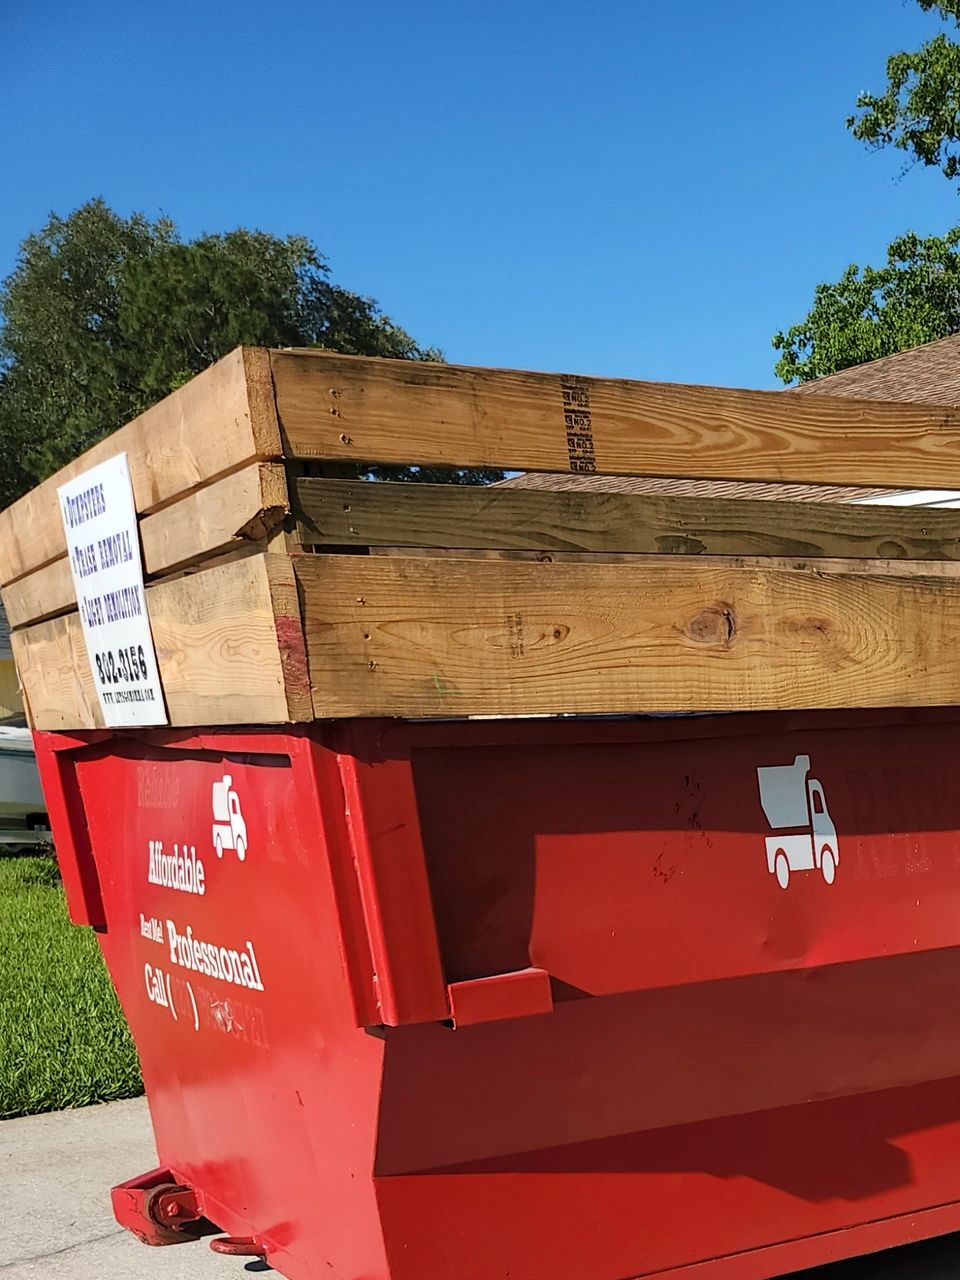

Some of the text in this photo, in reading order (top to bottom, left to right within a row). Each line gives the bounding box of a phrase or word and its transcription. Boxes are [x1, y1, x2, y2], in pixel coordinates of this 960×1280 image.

[95, 645, 148, 685] 802-3156
[148, 840, 205, 896] Affordable
[166, 919, 264, 992] Professional
[144, 963, 169, 1008] Call
